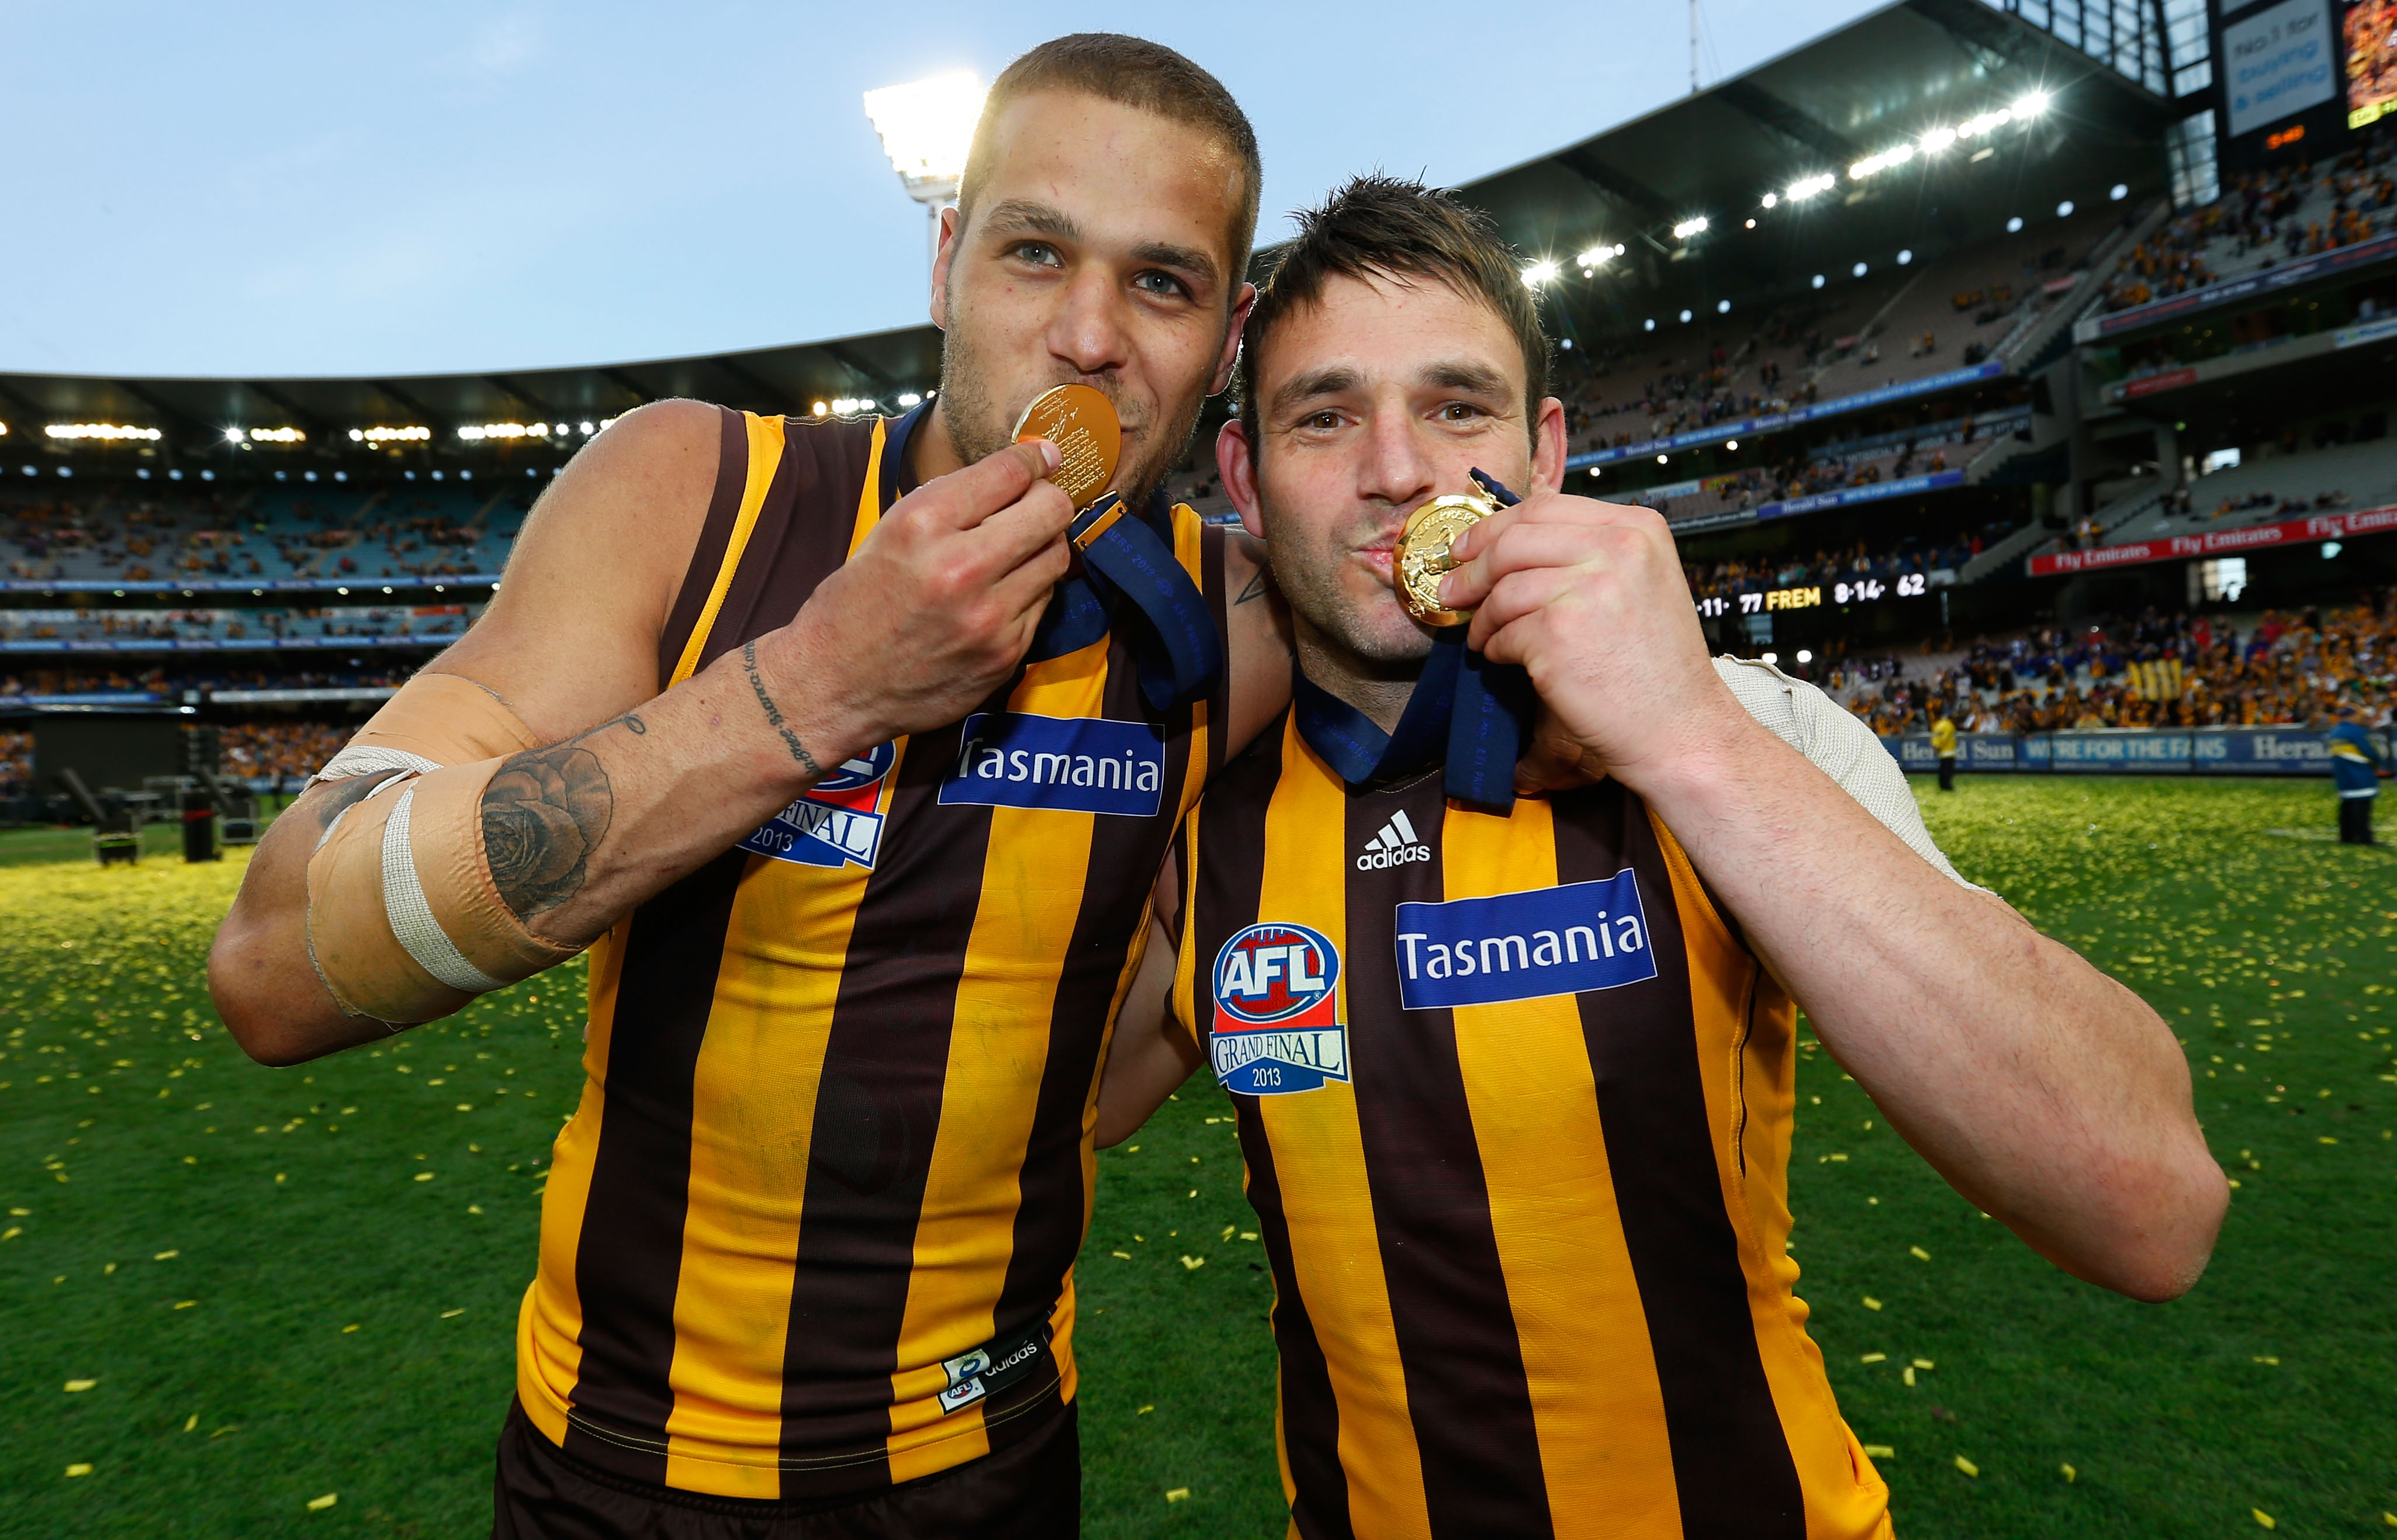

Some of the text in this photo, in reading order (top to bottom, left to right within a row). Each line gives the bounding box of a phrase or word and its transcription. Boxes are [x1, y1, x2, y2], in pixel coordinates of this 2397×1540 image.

[2171, 526, 2283, 554] Fly Emirates
[2307, 516, 2343, 537] Fly
[2055, 544, 2151, 569] Fly Emirates
[1739, 592, 1763, 614] 77
[1766, 586, 1821, 611] FREM
[1897, 573, 1926, 597] 62
[1971, 742, 2015, 760] Sun
[2083, 738, 2124, 759] FOR
[2127, 738, 2167, 758] THE
[958, 736, 1158, 792] Tasmania
[750, 827, 793, 852] 2013
[780, 802, 869, 857] FINAL
[1357, 843, 1431, 871] adidas
[1398, 910, 1644, 981] Tasmania
[1220, 944, 1326, 1001] AFL
[1215, 1033, 1340, 1074] GRAND FINAL
[1252, 1067, 1282, 1087] 2013
[949, 1382, 972, 1398] AFL
